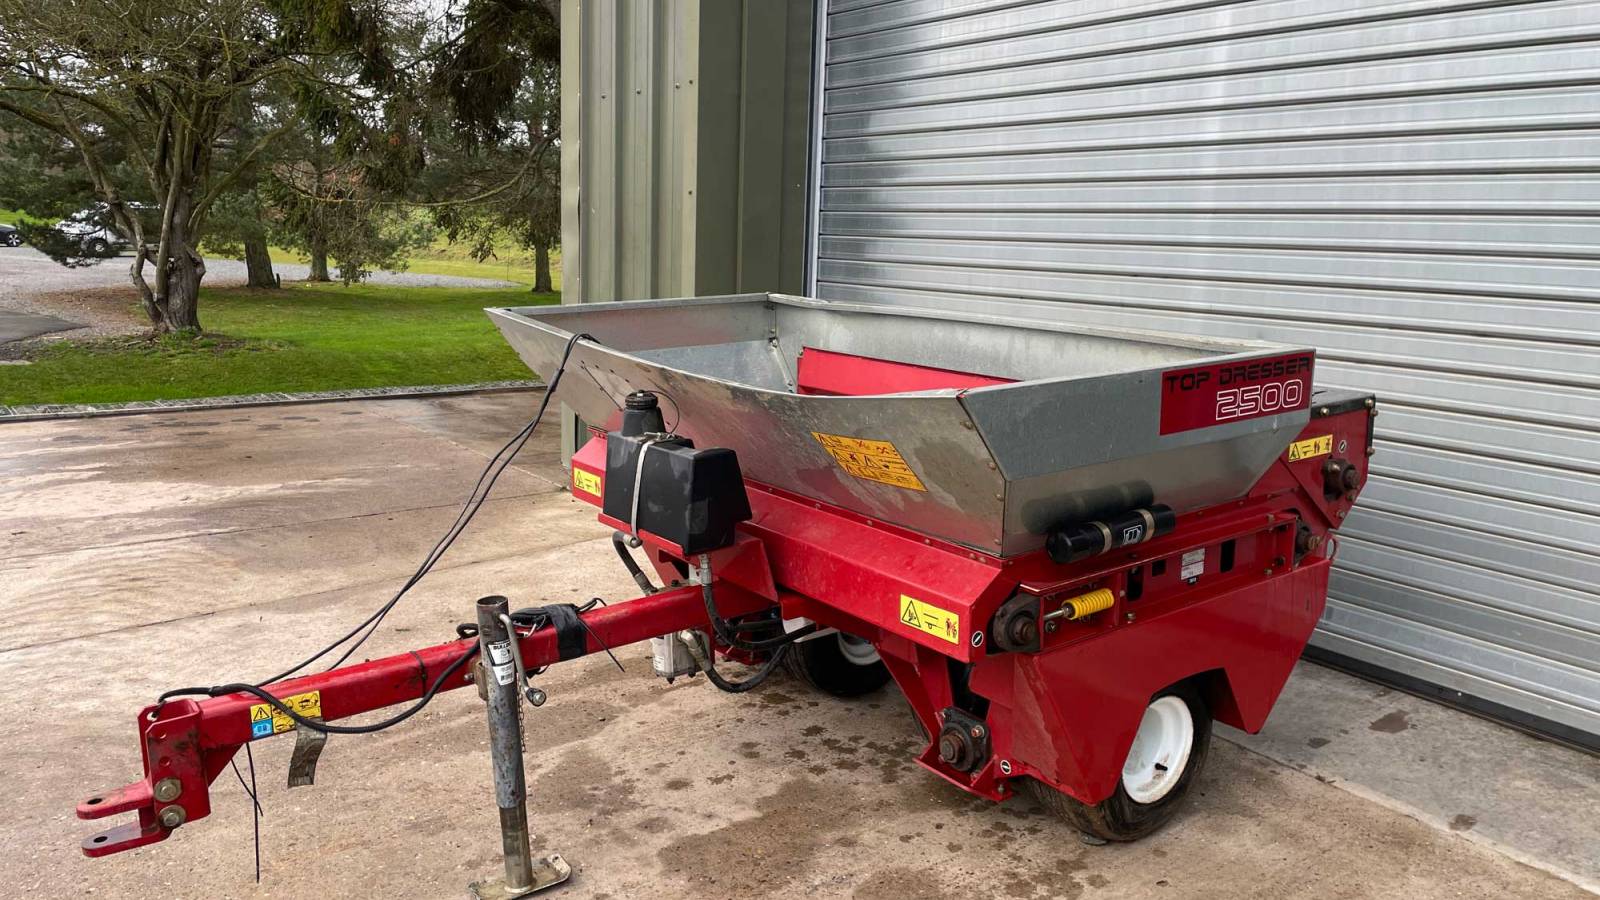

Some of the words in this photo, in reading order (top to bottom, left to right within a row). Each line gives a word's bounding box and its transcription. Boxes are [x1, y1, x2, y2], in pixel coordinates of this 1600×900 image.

[1167, 371, 1210, 392] TOP
[1219, 357, 1309, 385] DRESSER
[1216, 379, 1303, 420] 2500
